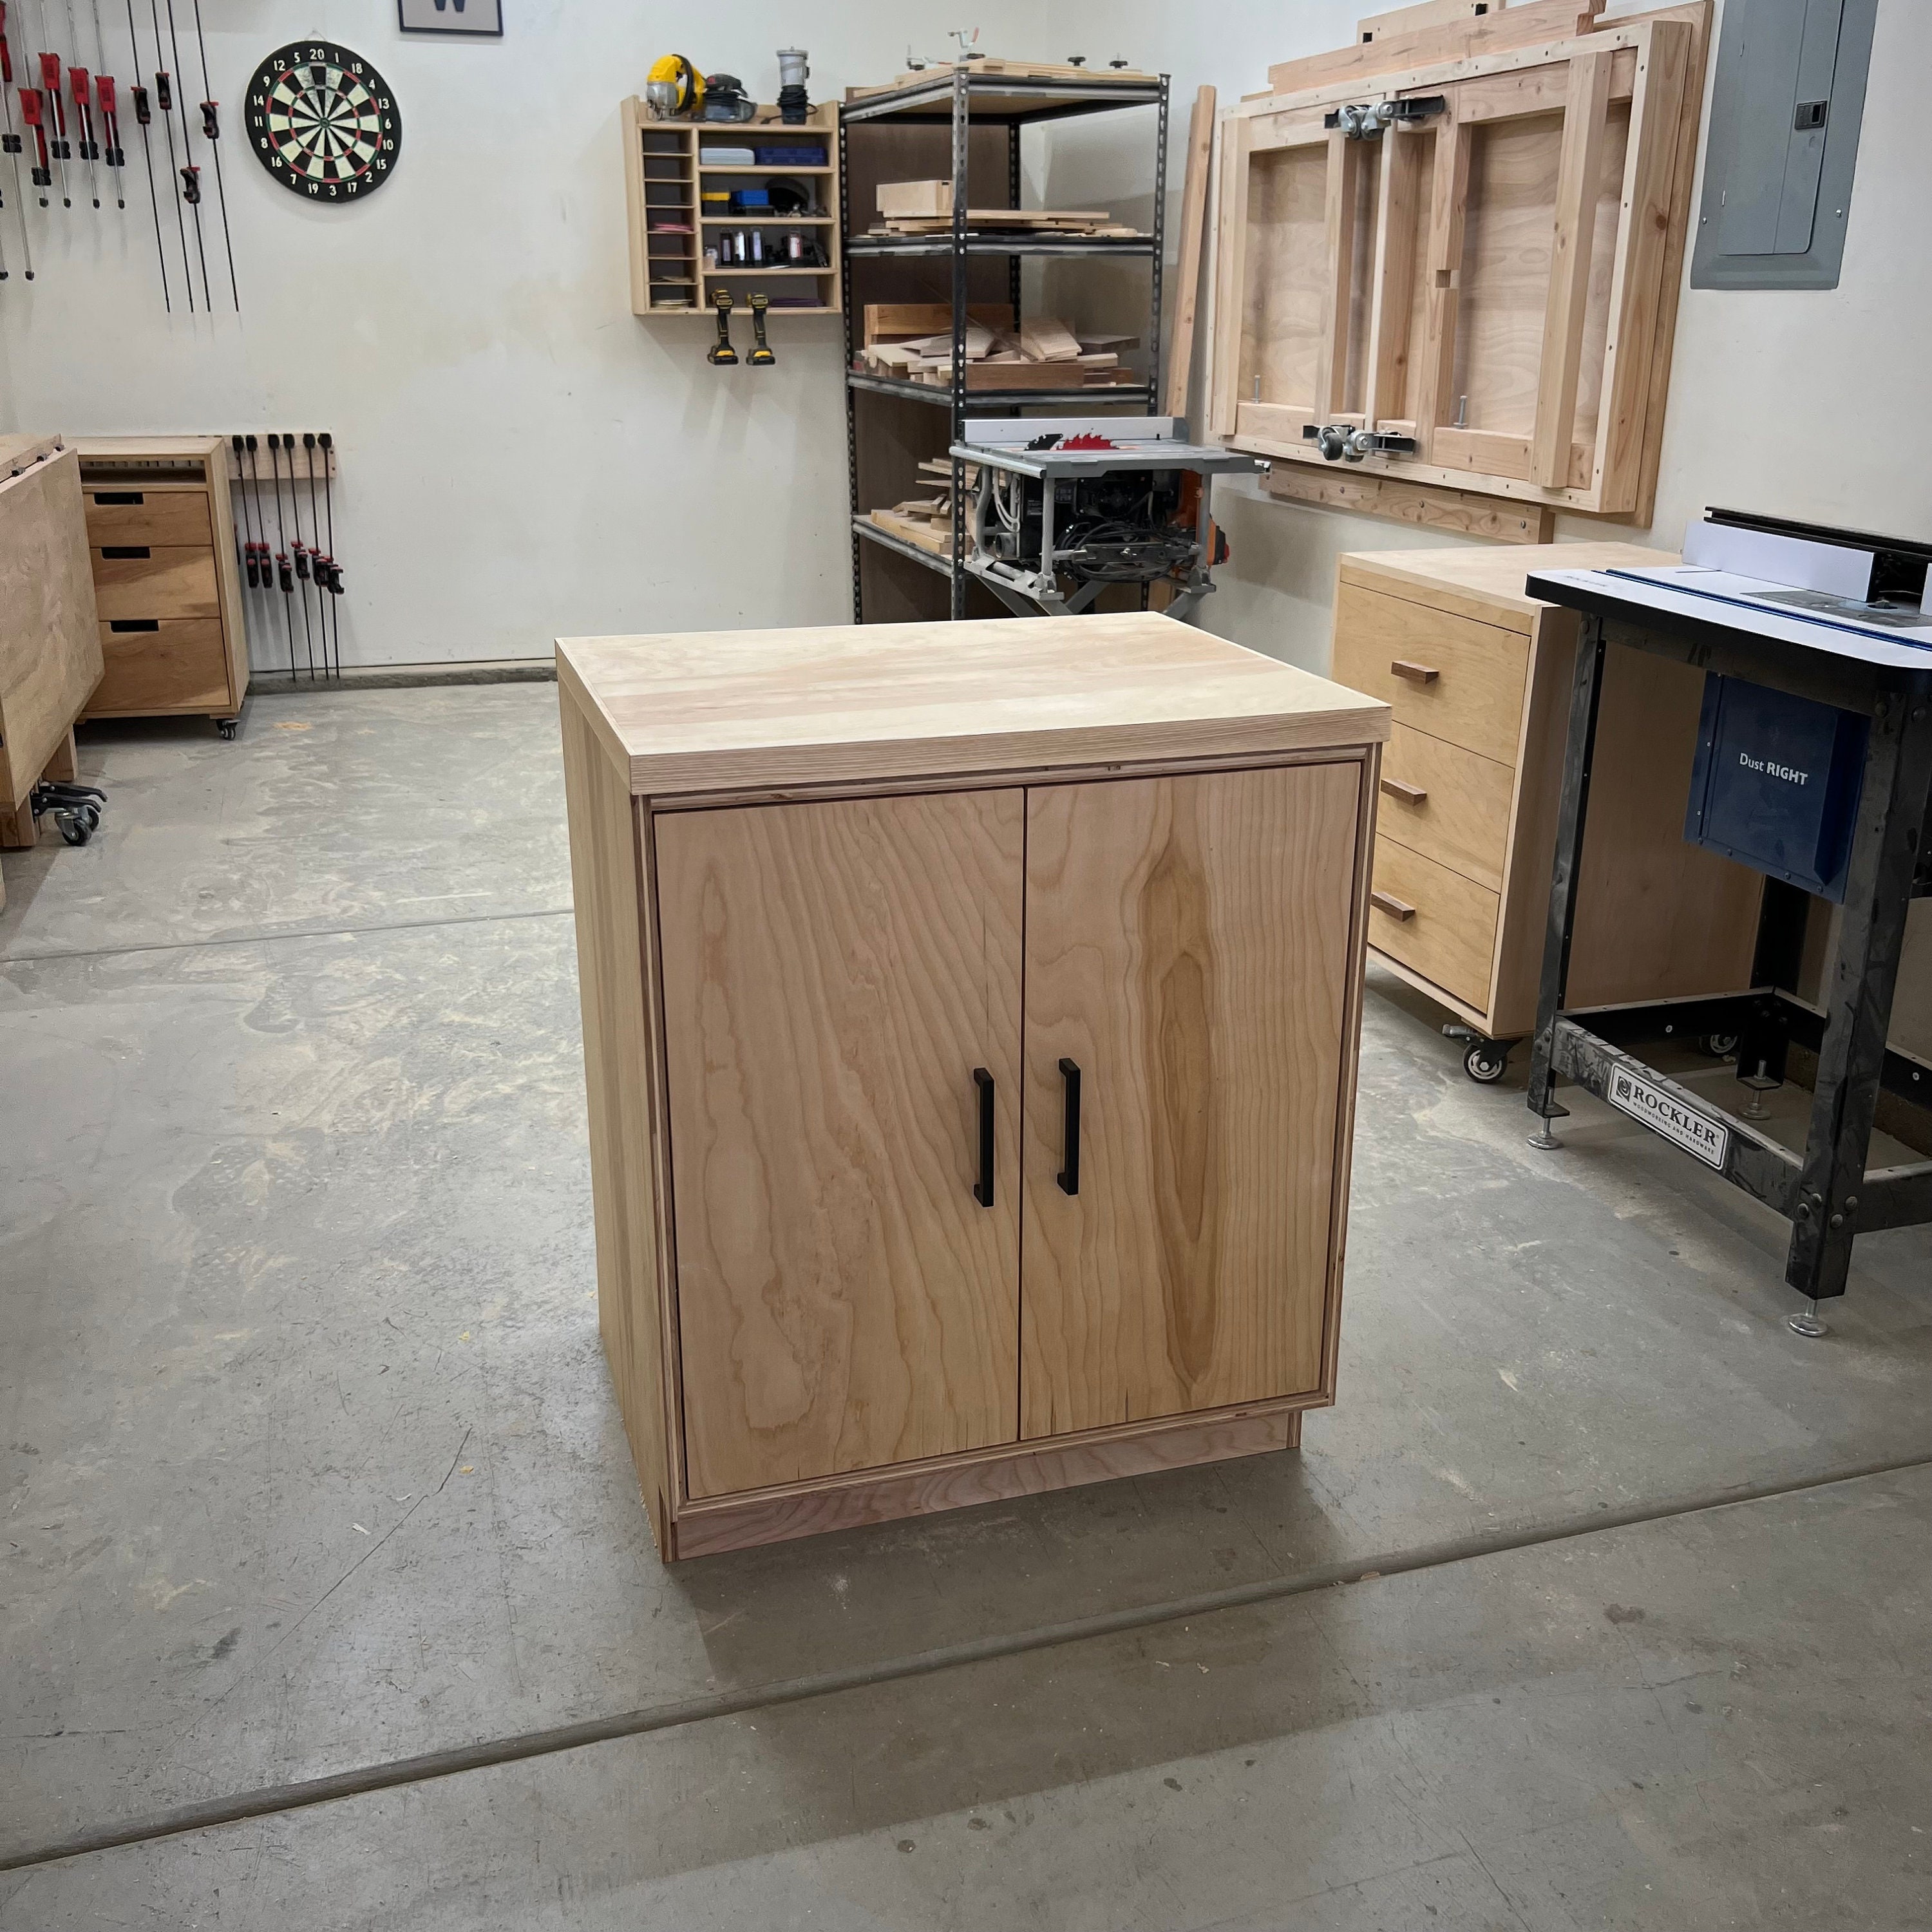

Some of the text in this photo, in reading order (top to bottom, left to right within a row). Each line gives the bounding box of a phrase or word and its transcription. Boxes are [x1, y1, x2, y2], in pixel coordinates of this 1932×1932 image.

[294, 52, 301, 63] 5
[309, 48, 325, 61] 20
[335, 52, 339, 63] 1
[273, 59, 286, 71] 12
[351, 62, 363, 74] 18
[263, 75, 270, 87] 9
[368, 79, 375, 90] 4
[253, 95, 264, 106] 14
[378, 98, 390, 109] 13
[254, 116, 263, 127] 11
[384, 118, 392, 129] 6
[260, 137, 269, 149] 8
[383, 139, 394, 151] 10
[271, 156, 283, 167] 16
[376, 159, 387, 170] 15
[290, 173, 297, 185] 7
[365, 171, 373, 183] 2
[308, 183, 319, 194] 19
[329, 185, 337, 196] 3
[347, 182, 357, 193] 17
[1739, 752, 1808, 785] Dust RIGHT
[1633, 1085, 1716, 1147] ROCKLER
[1633, 1101, 1714, 1155] WOODWORKING AND HARDWARE
